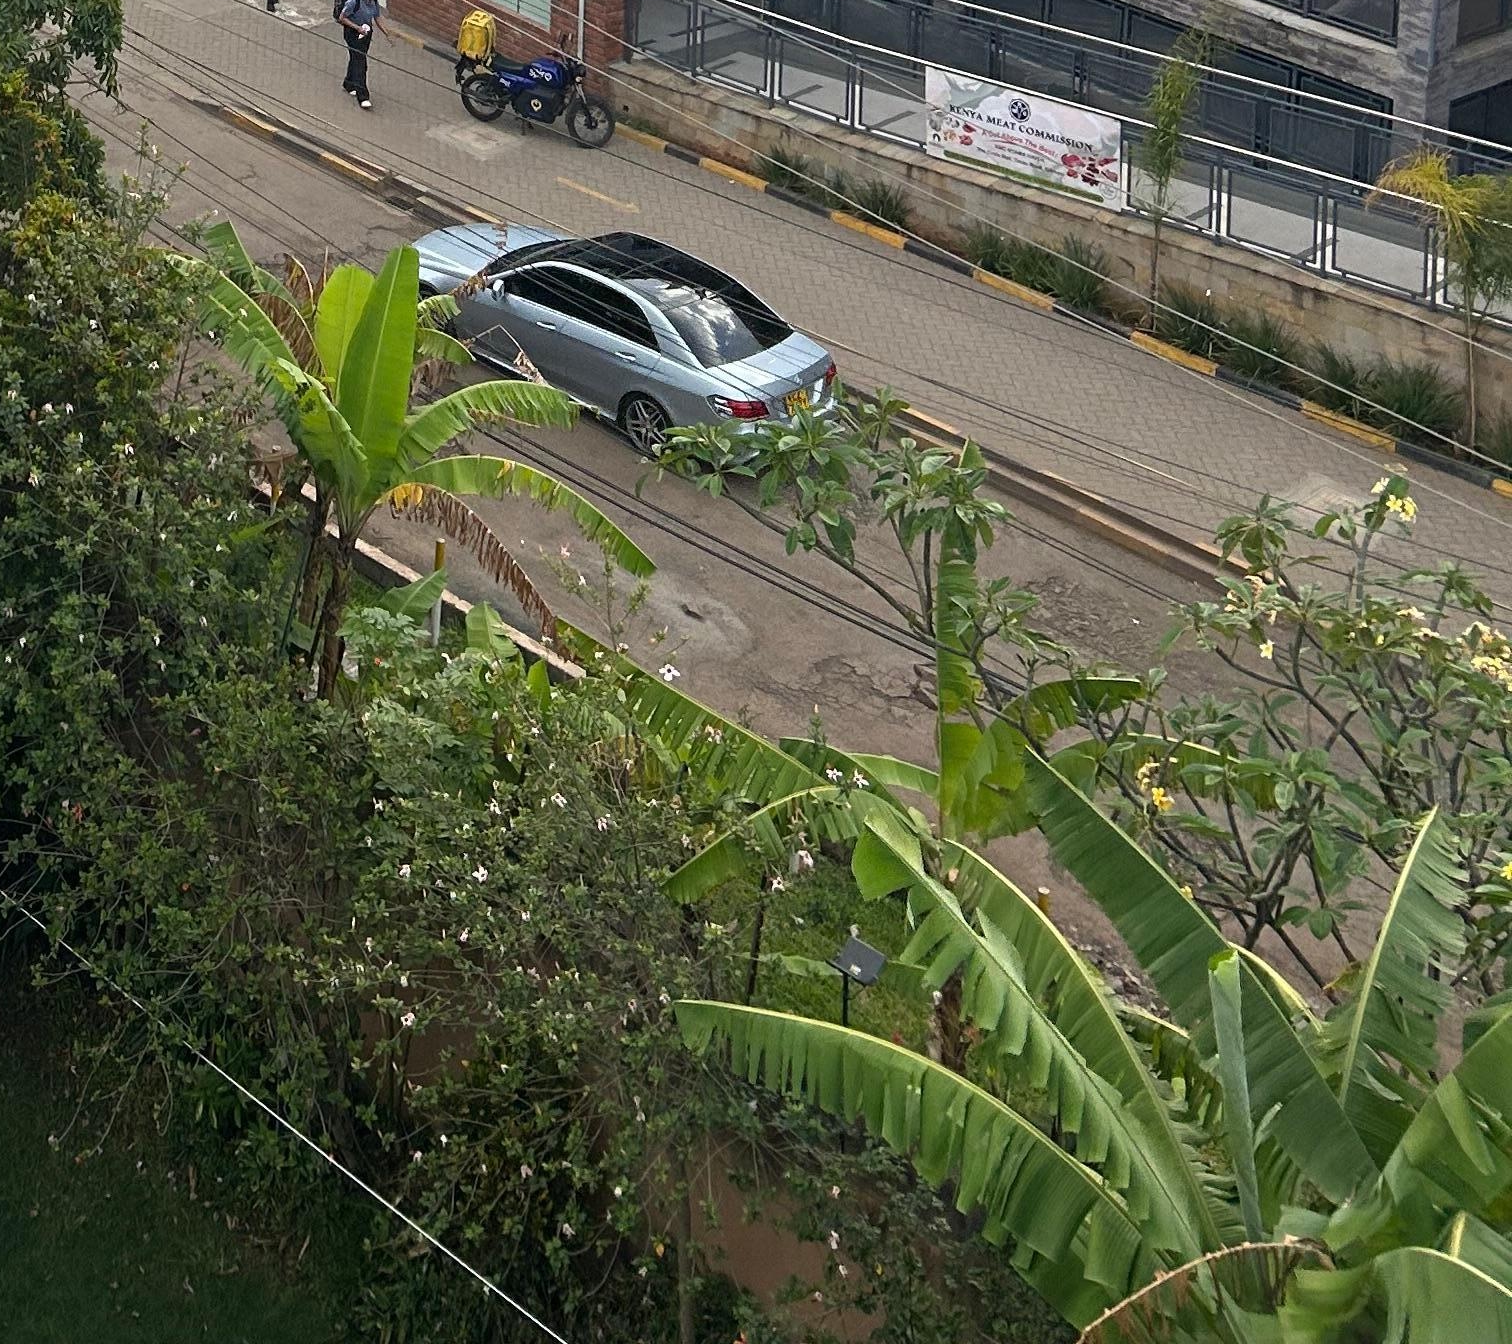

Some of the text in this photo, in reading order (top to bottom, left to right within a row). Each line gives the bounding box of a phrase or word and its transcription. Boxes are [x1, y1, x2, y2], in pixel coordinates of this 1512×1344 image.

[949, 104, 984, 121] KENYA
[986, 115, 1016, 131] MEAT
[1018, 125, 1095, 153] COMMISSION
